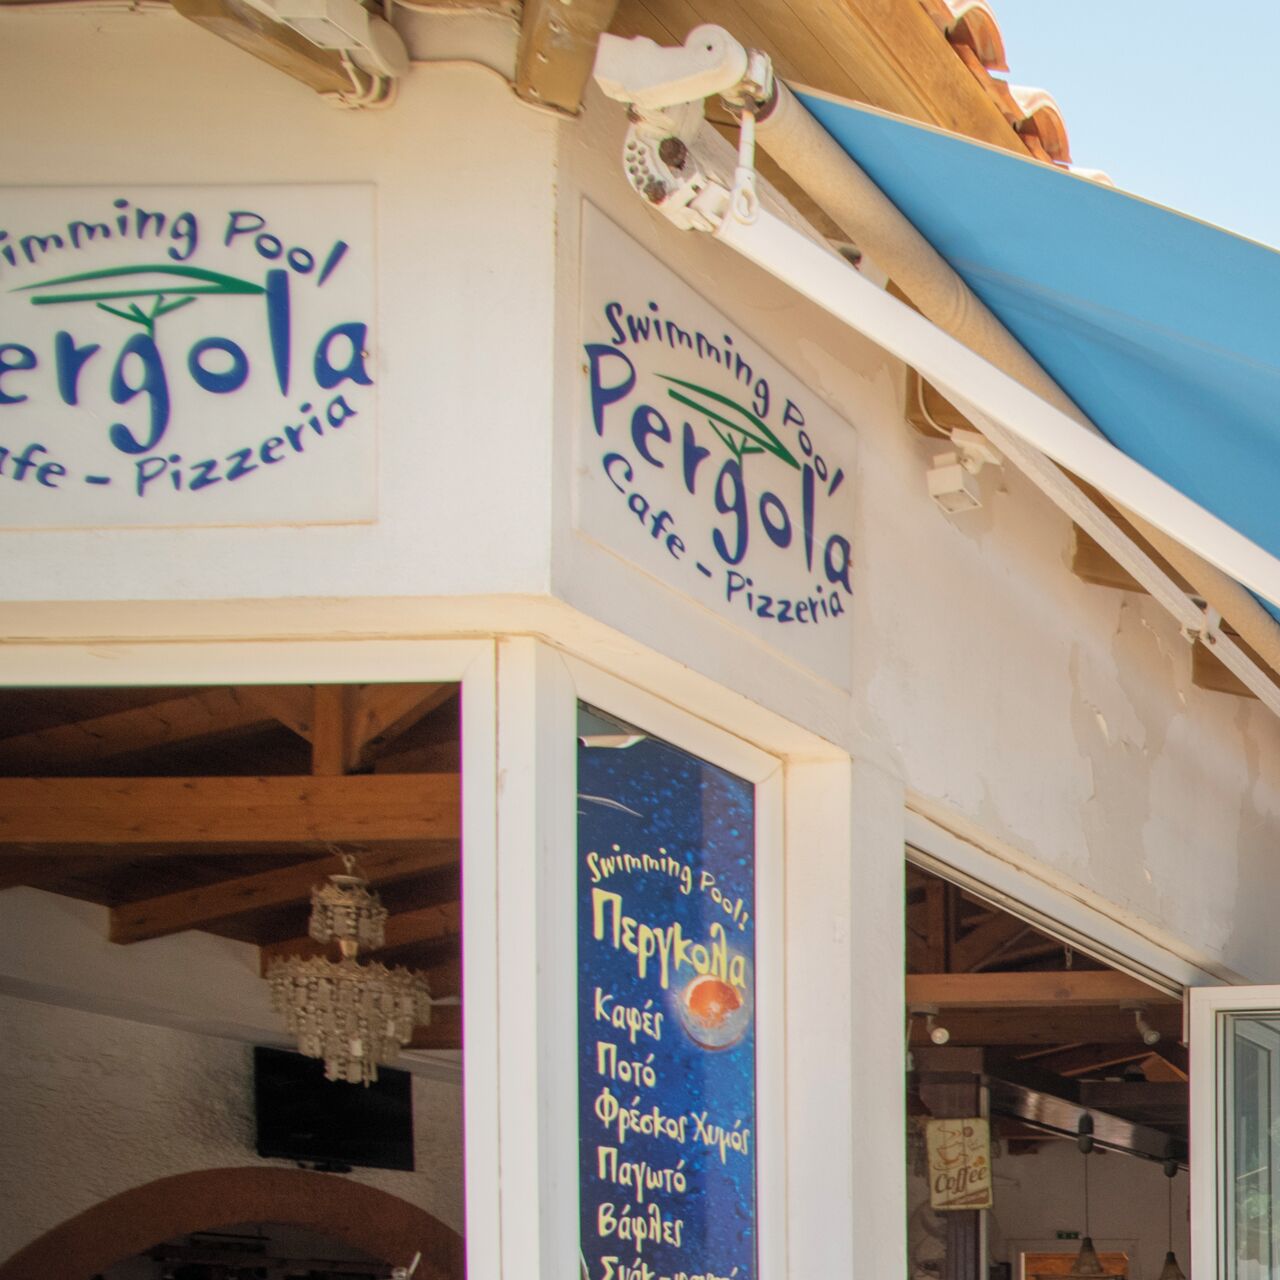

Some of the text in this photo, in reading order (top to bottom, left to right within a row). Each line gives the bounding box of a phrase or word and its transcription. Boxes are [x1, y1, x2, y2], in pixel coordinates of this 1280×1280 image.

[224, 211, 349, 287] Pool
[605, 301, 844, 497] Swimming Pool
[135, 395, 357, 497] Pizzeria
[583, 343, 853, 595] Pergola
[603, 453, 686, 560] Cafe
[727, 570, 844, 624] Pizzeria
[587, 844, 749, 931] Swimming Pool!
[592, 887, 746, 989] Περγκολα
[595, 987, 664, 1044] Καφές
[597, 1041, 656, 1087] Ποτό
[595, 1087, 750, 1165] Φρέσκος Χυμός
[597, 1146, 686, 1203] Παγωτό
[934, 1166, 987, 1194] Coffee
[598, 1202, 684, 1253] Βάφλες
